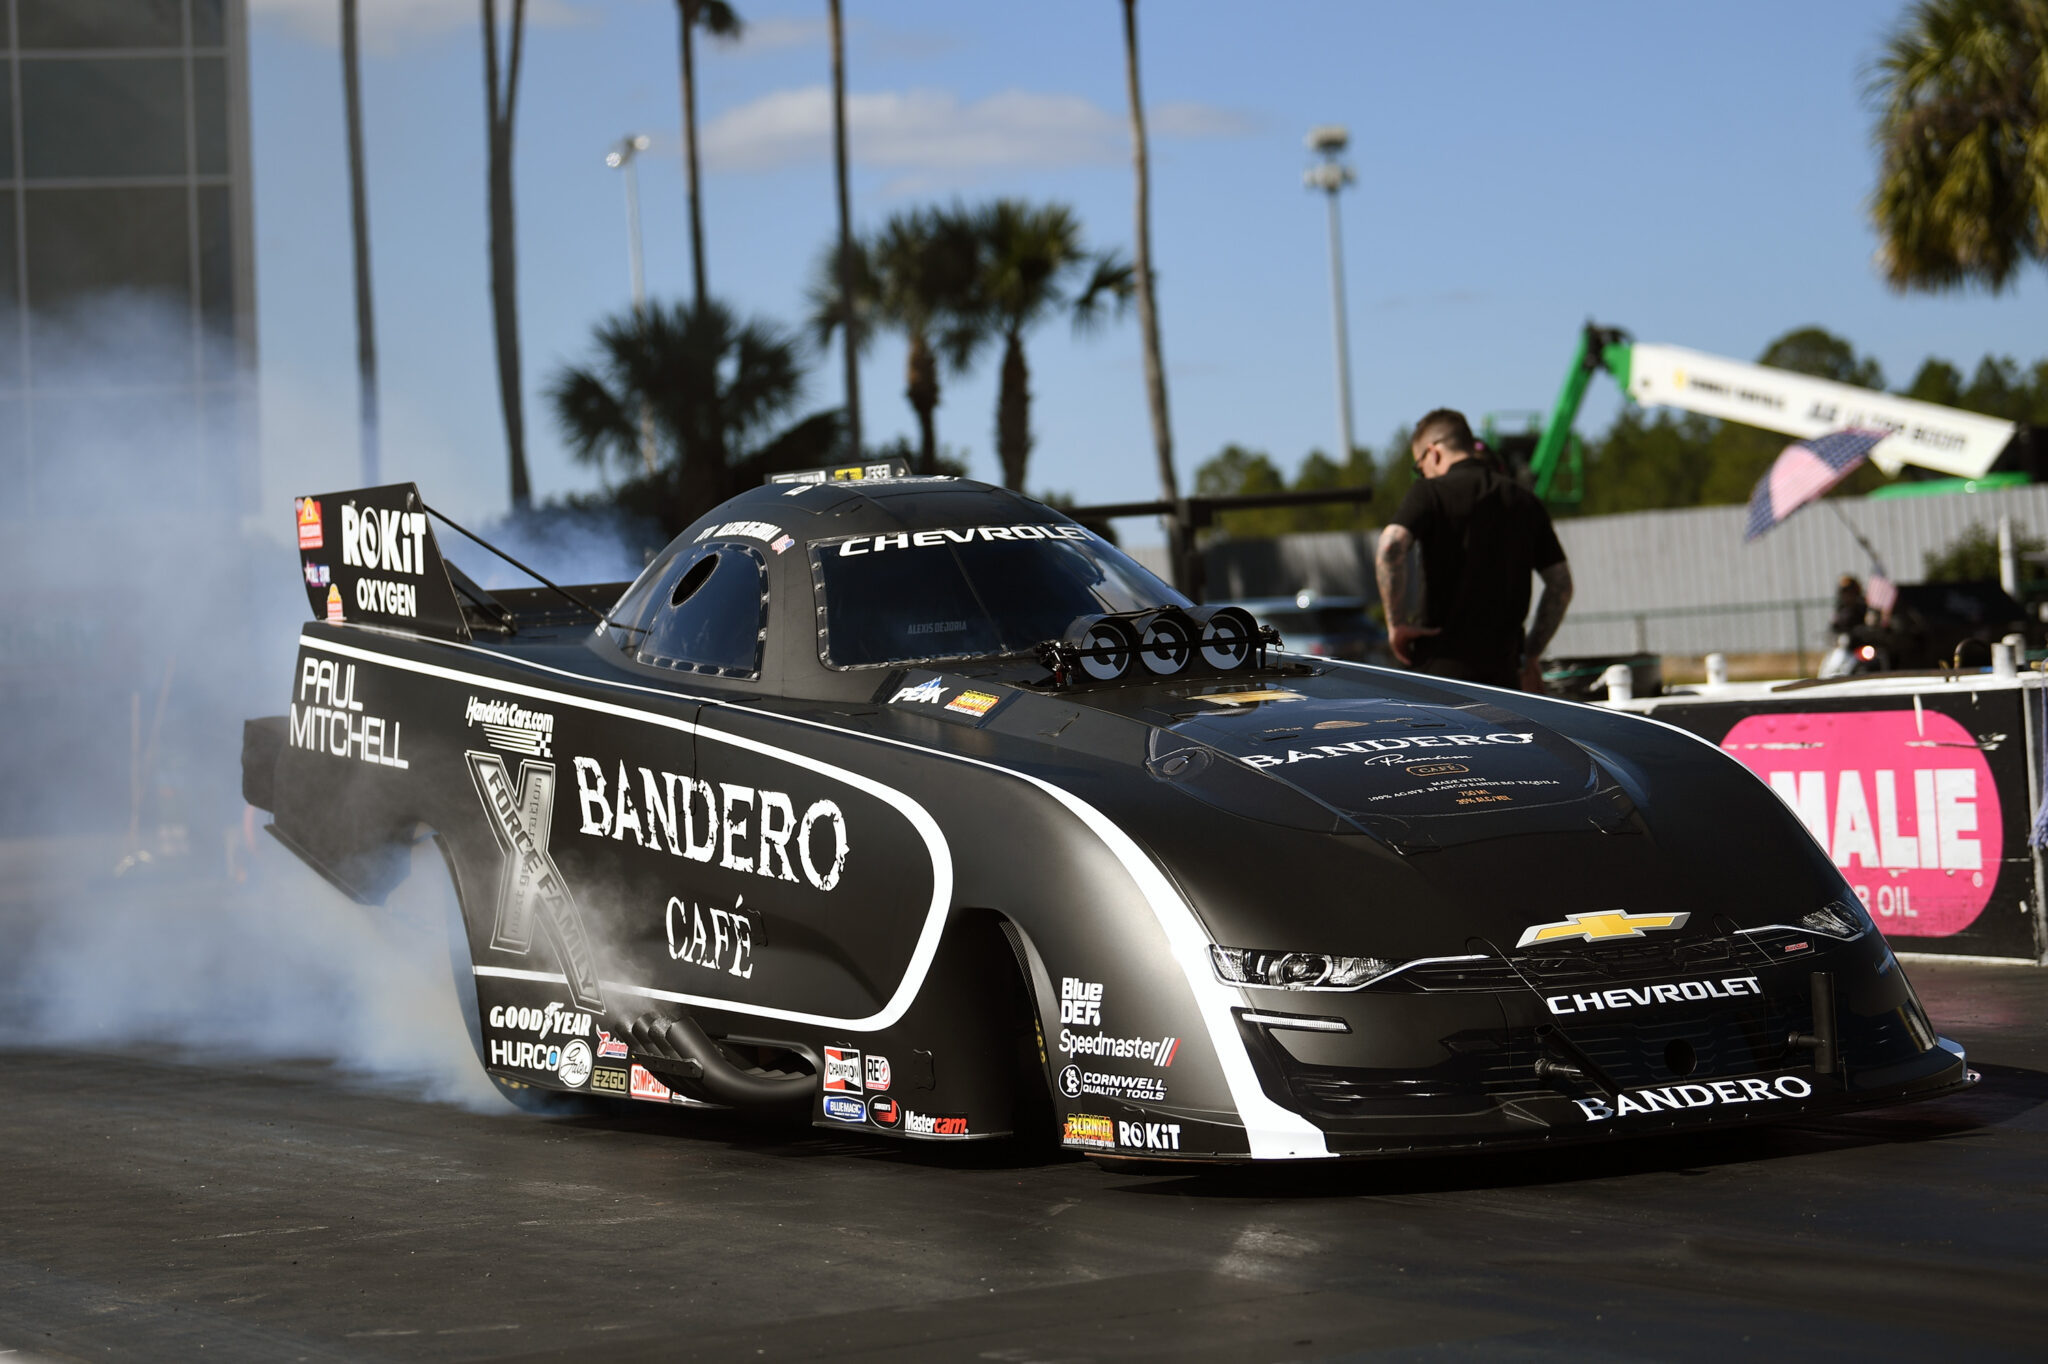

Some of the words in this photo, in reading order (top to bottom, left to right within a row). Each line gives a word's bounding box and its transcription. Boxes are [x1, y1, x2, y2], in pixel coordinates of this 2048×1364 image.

[839, 525, 1095, 557] CHEVROLET
[356, 577, 416, 618] OXYGEN
[907, 622, 934, 635] ALEXIS
[934, 620, 967, 633] DEJORIA
[301, 656, 363, 712] PAUL
[289, 703, 409, 770] MITCHELL
[1239, 732, 1534, 773] BANDERO
[1364, 754, 1473, 767] Premium
[1367, 794, 1393, 802] 100%
[1394, 788, 1425, 797] AGAVE
[1426, 783, 1468, 791] BLANCO
[572, 755, 850, 892] BANDERO
[1769, 768, 1983, 871] MALIE
[489, 770, 543, 874] FORCE
[537, 873, 594, 991] FAMILY
[1877, 885, 1918, 918] OIL
[665, 894, 754, 980] CAFÉ
[1062, 977, 1104, 1002] Blue
[1546, 976, 1762, 1016] CHEVROLET
[1060, 1000, 1101, 1026] DEF
[490, 1039, 561, 1071] HURCO
[1059, 1029, 1160, 1060] Speedmaster
[828, 1062, 859, 1078] CHAMPION
[1083, 1072, 1166, 1091] CORNWELL
[1083, 1085, 1122, 1097] QUALITY
[1126, 1089, 1165, 1100] TOOLS
[1571, 1075, 1812, 1122] BANDERO
